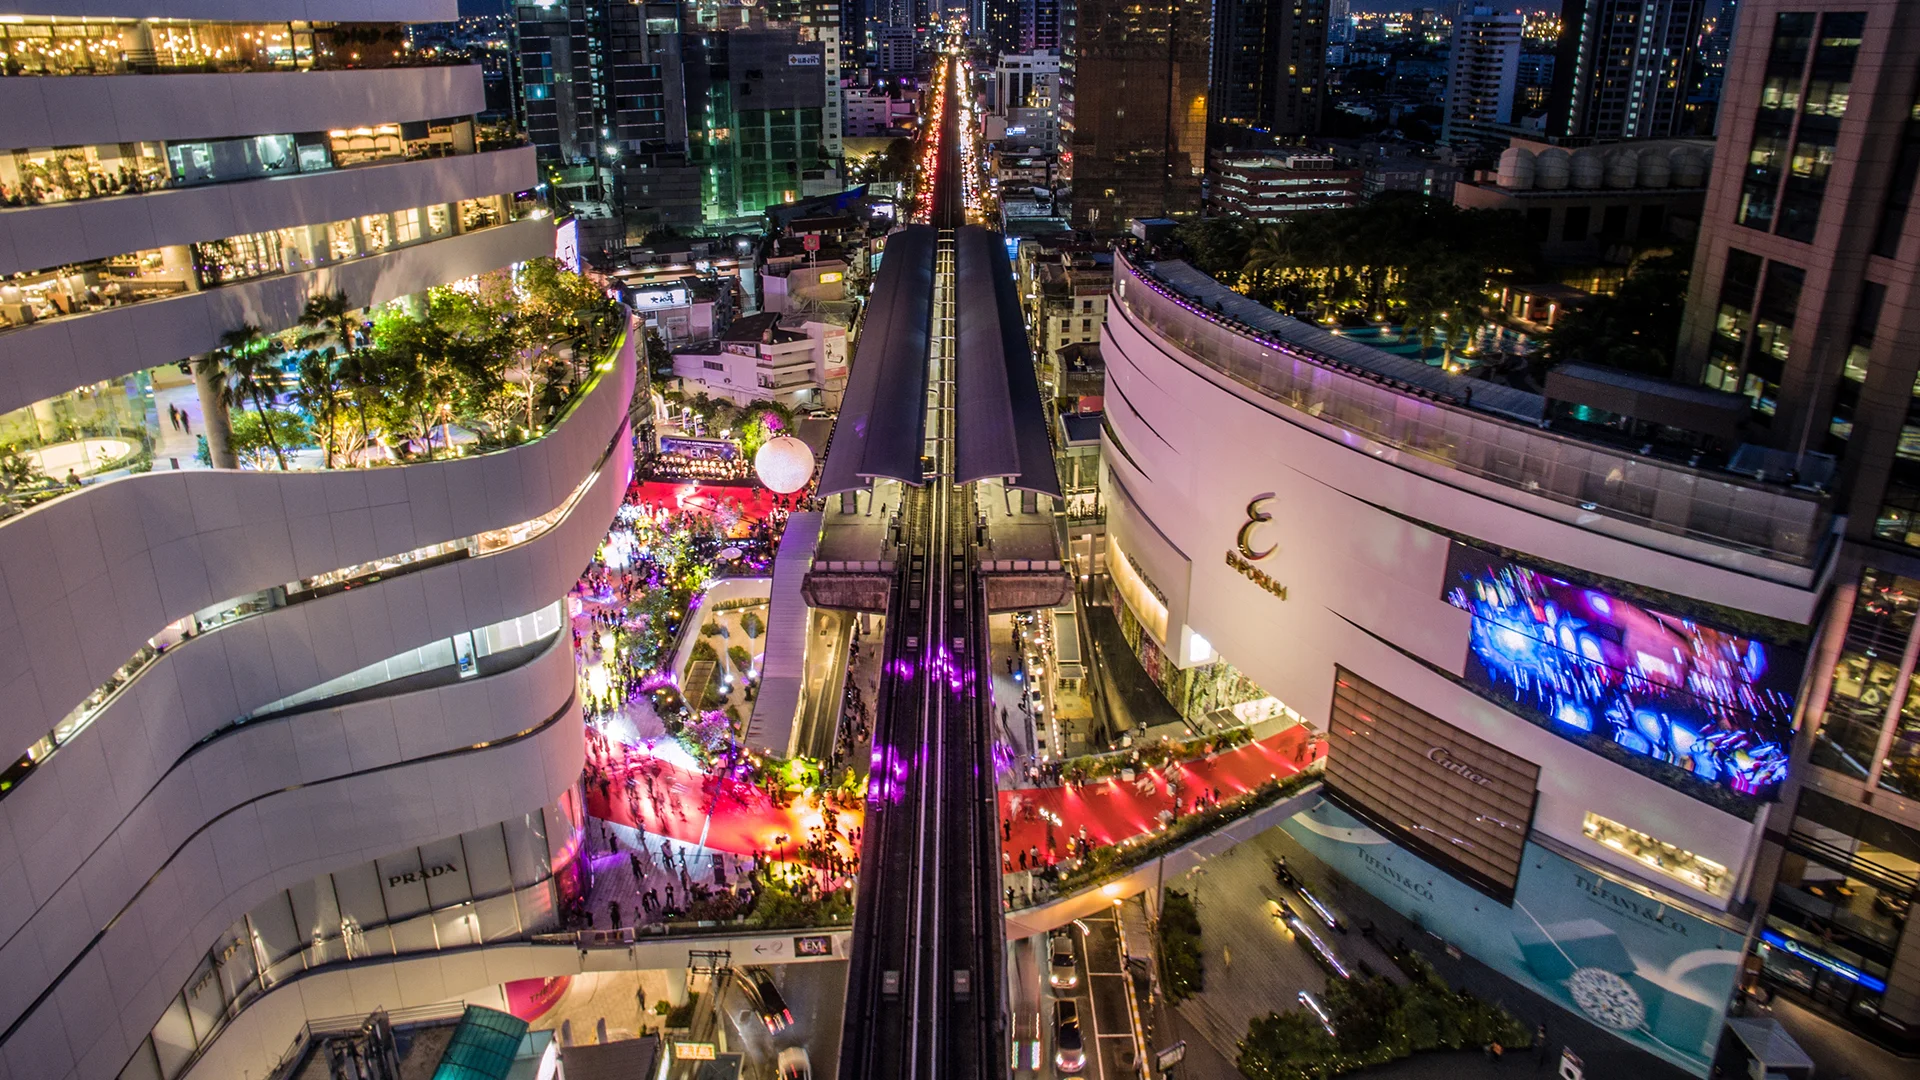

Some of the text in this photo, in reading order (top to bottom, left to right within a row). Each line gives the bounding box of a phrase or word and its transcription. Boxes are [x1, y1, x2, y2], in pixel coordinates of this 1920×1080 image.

[1226, 549, 1287, 601] EMPORIUM
[1427, 747, 1493, 787] Cartier
[388, 862, 457, 888] PRADA
[805, 940, 822, 951] EM
